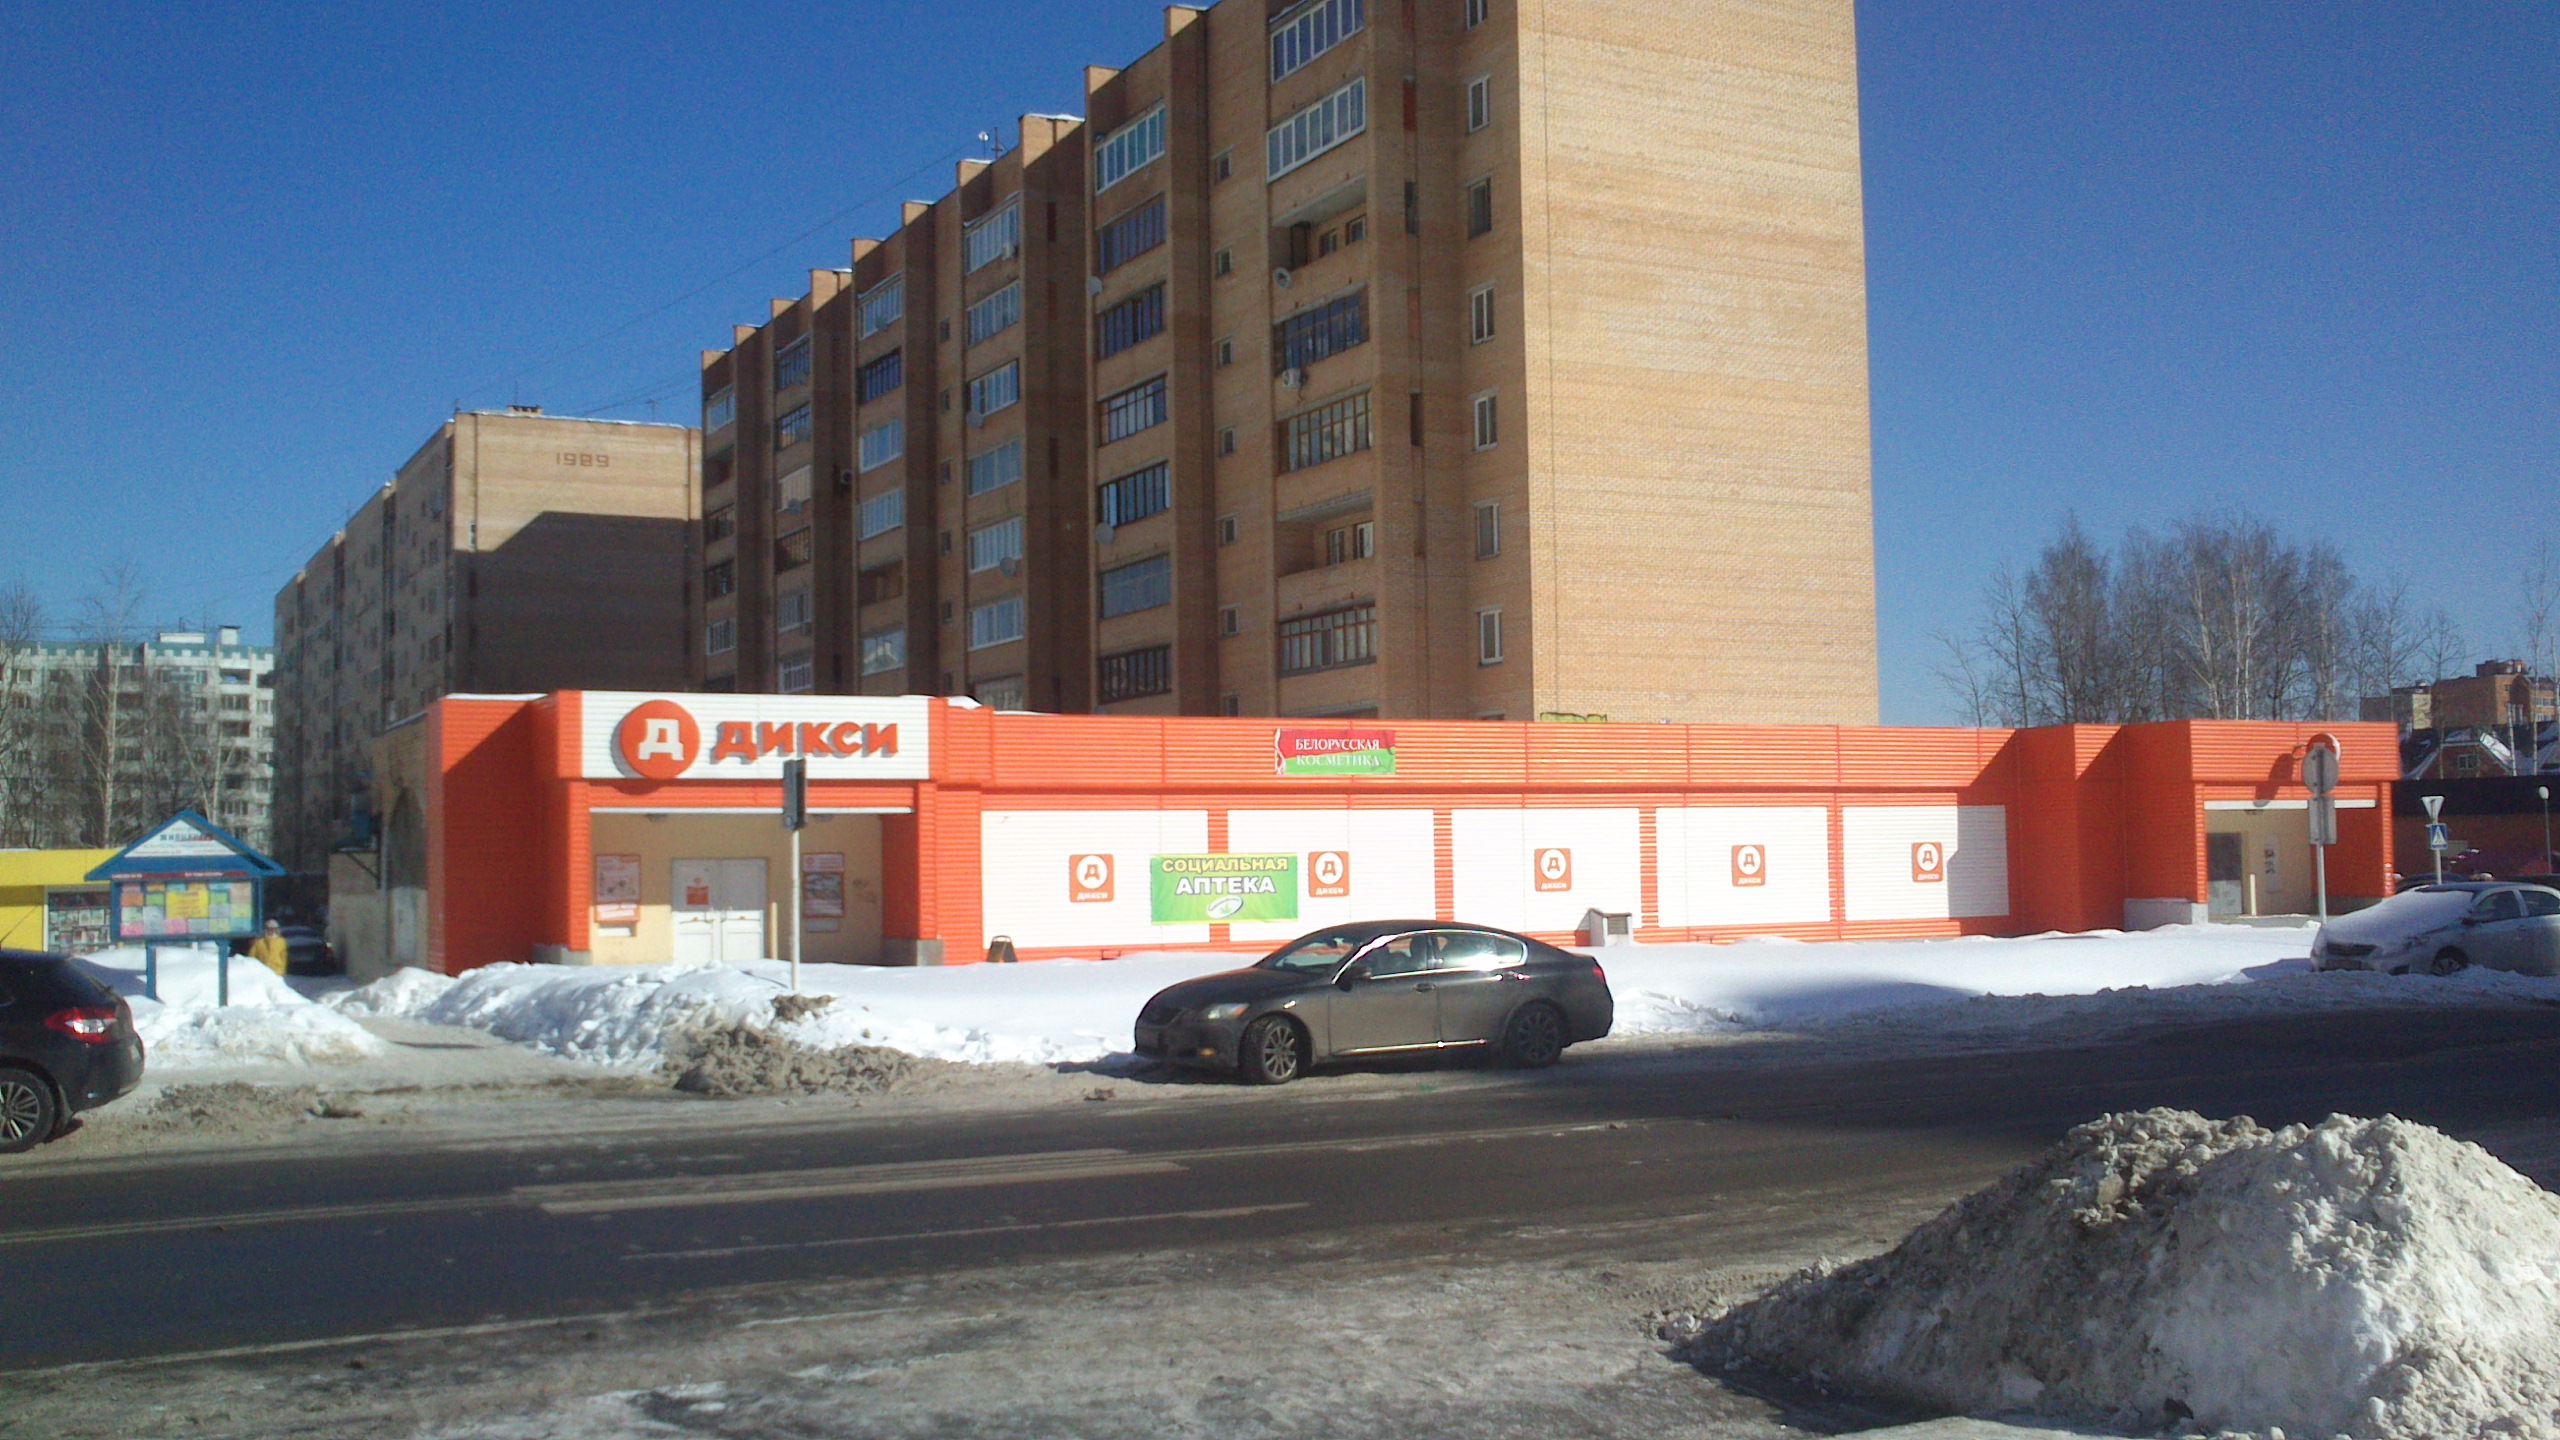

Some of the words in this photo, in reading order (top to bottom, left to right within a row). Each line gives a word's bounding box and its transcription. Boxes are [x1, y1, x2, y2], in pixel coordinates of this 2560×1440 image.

[556, 453, 610, 468] 1989
[638, 718, 684, 761] Д
[714, 721, 899, 761] ДИКСИ
[1295, 738, 1380, 751] БЕЛОРУССКАЯ
[1296, 754, 1380, 767] КОСМЕТИКА
[1161, 857, 1289, 874] СОЦИАЛЬНАЯ
[1175, 876, 1277, 895] АПТЕКА
